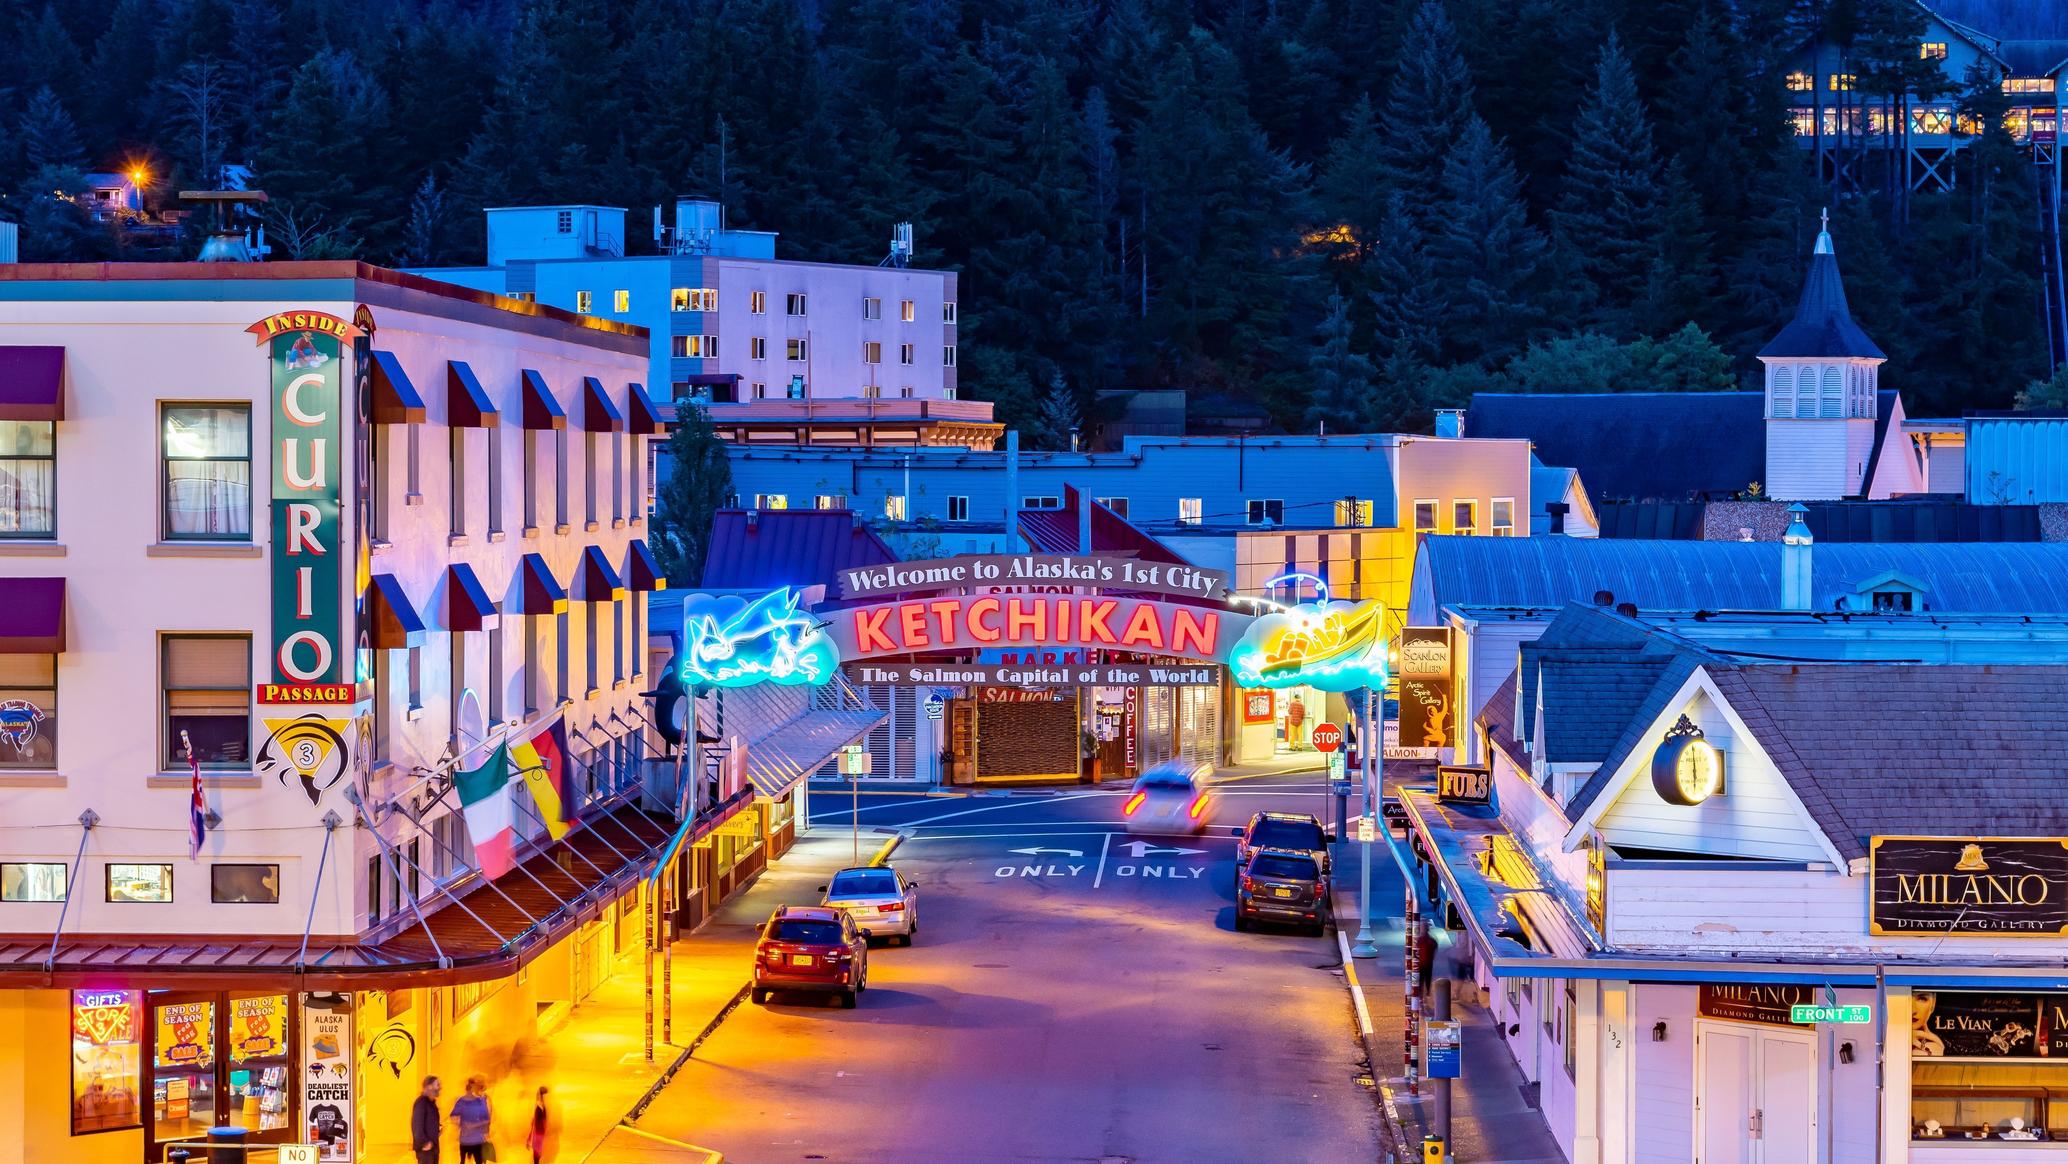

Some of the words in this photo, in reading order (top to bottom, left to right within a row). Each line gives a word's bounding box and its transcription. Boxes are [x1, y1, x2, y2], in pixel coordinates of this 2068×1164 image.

[264, 314, 348, 337] INSIDE
[277, 373, 332, 684] CURIO
[848, 565, 966, 592] Welcome
[973, 560, 1000, 579] to
[1006, 556, 1113, 581] Alaska's
[1122, 562, 1160, 585] 1st
[1166, 567, 1219, 598] City
[854, 597, 1220, 656] KETCHIKAN
[1001, 651, 1119, 665] MARKET
[1403, 649, 1447, 661] SCANLON
[1405, 661, 1443, 674] GALLERY
[860, 668, 900, 682] The
[909, 668, 986, 682] Salmon
[996, 668, 1069, 685] Capital
[1078, 669, 1099, 683] of
[1107, 669, 1140, 683] the
[1149, 669, 1209, 683] World
[1406, 681, 1424, 689] Arctic
[265, 685, 349, 701] PASSAGE
[984, 688, 1054, 702] SALMON
[1413, 689, 1431, 698] Spirit
[1126, 686, 1135, 763] COFFEE
[1313, 732, 1340, 744] STOP
[299, 743, 315, 765] 3
[1382, 749, 1418, 757] ALMON
[1441, 771, 1488, 798] FURS
[994, 864, 1086, 878] ONLY
[1116, 865, 1206, 879] ONLY
[1897, 873, 2048, 906] MILANO
[1897, 919, 1969, 928] DIAMOND
[1978, 919, 2046, 929] GALLERY
[86, 994, 122, 1007] GIFTS
[1711, 985, 1801, 1006] MILANO
[239, 999, 259, 1008] END
[262, 997, 274, 1006] OF
[165, 1006, 186, 1015] END
[189, 1004, 202, 1013] OF
[237, 1006, 275, 1018] SEASON
[1712, 1008, 1754, 1018] DIAMOND
[1759, 1013, 1792, 1023] GALLE
[1796, 1008, 1845, 1020] FRONT
[164, 1014, 203, 1025] SEASON
[319, 1025, 339, 1033] ULUS
[307, 1090, 349, 1101] CATCH
[288, 1150, 307, 1162] NO
